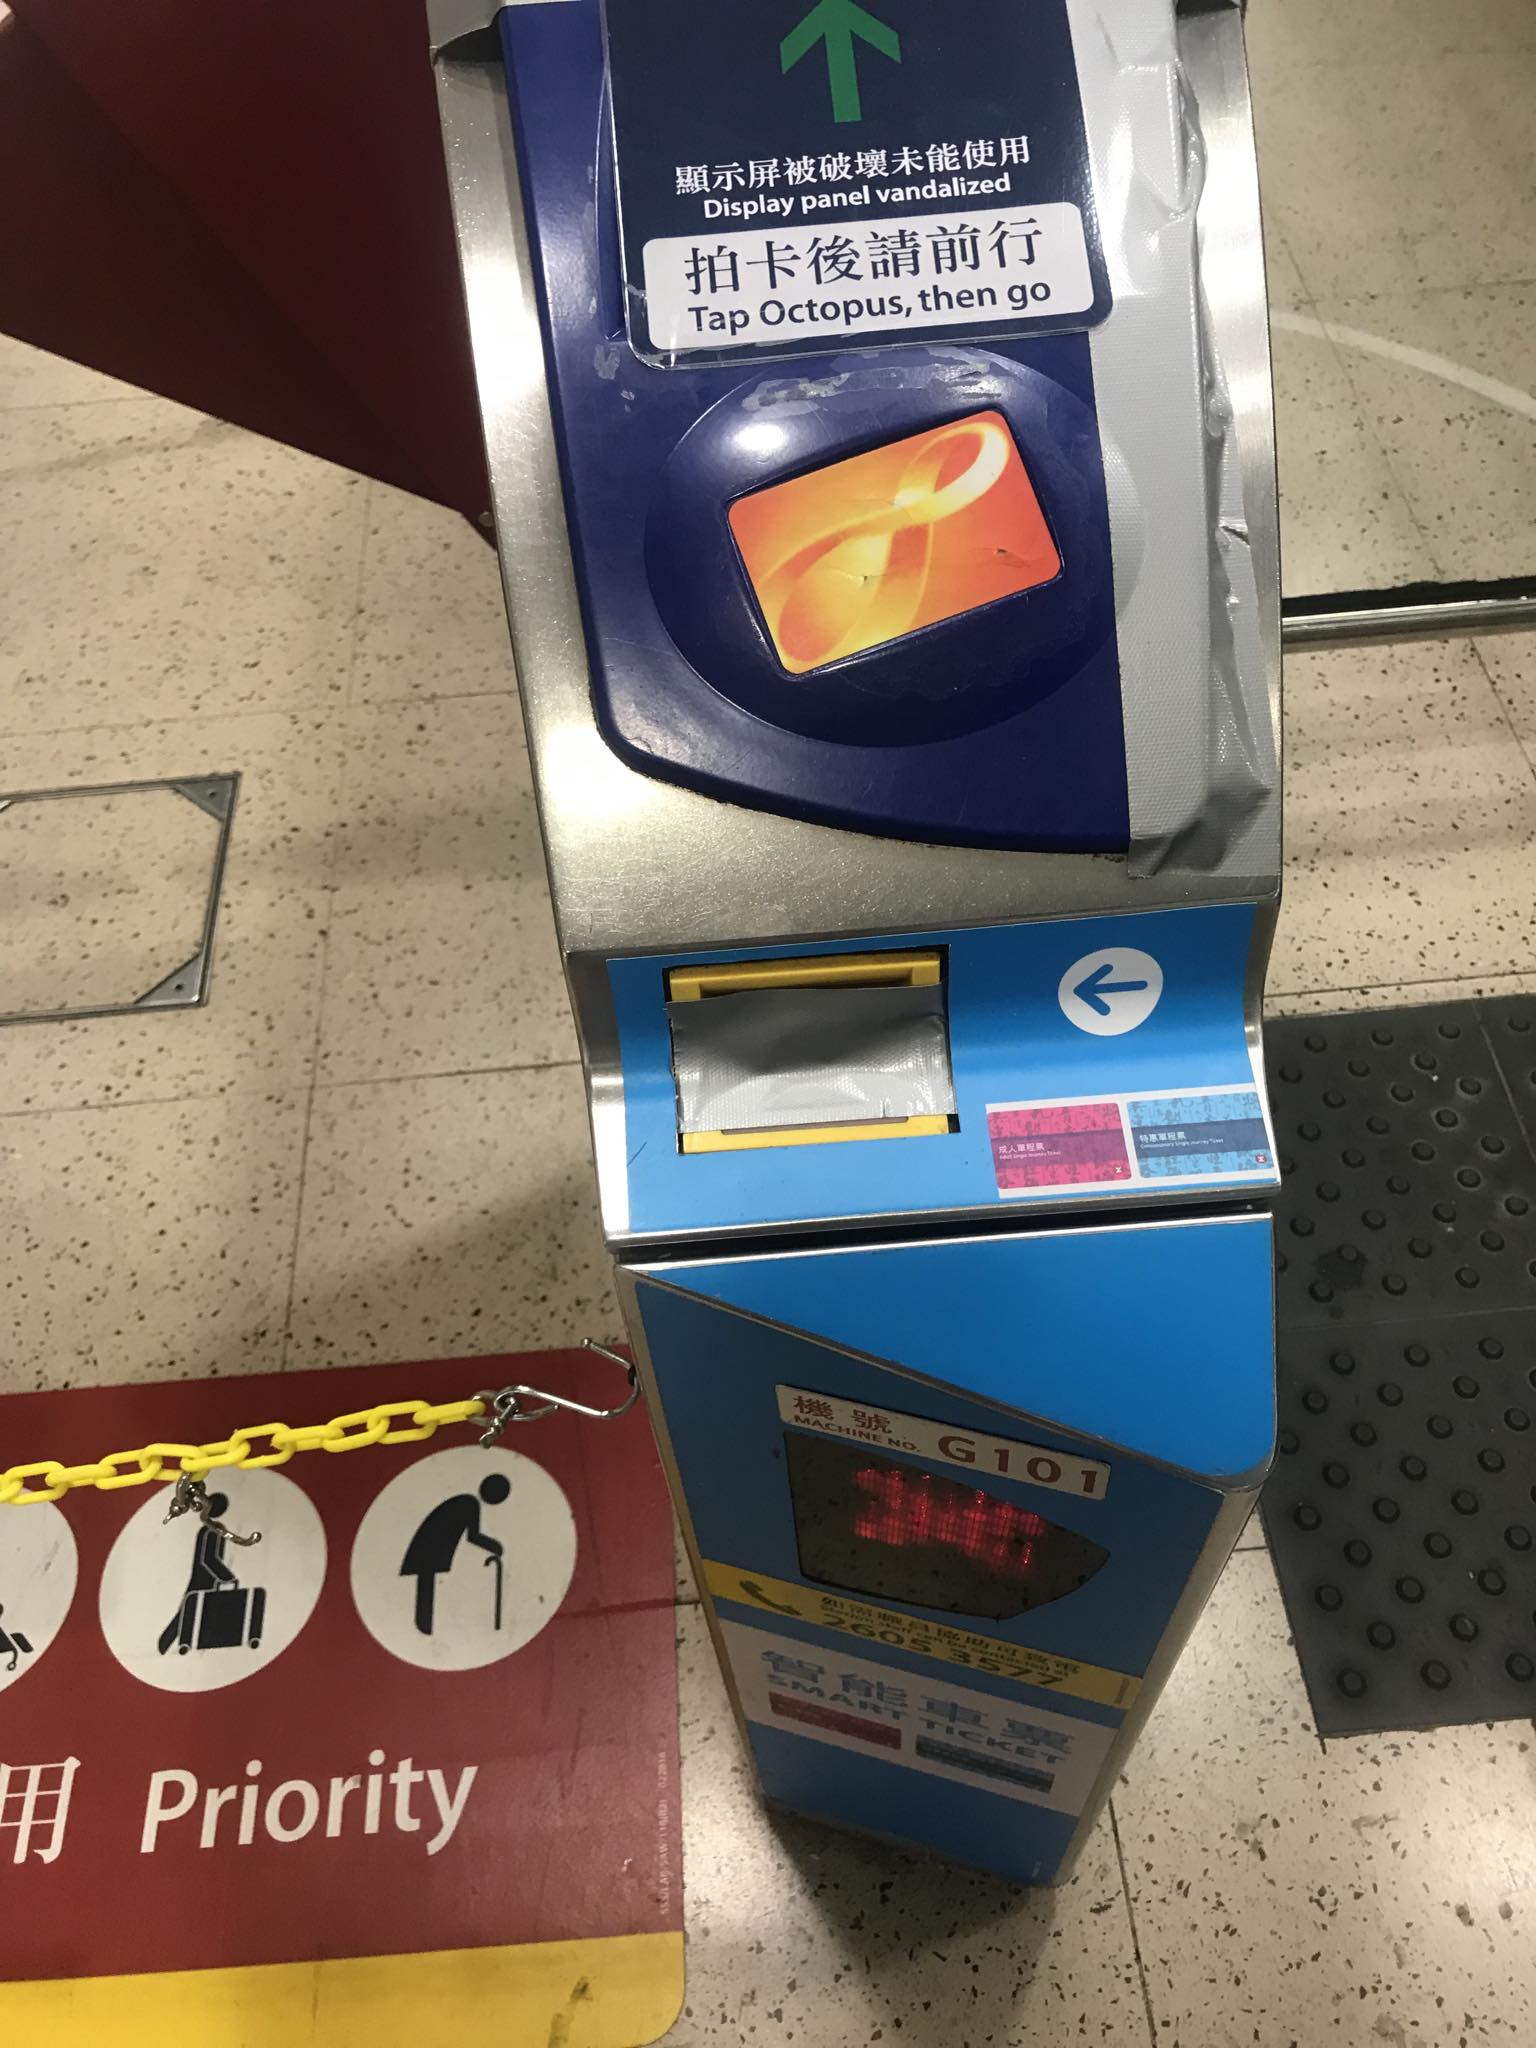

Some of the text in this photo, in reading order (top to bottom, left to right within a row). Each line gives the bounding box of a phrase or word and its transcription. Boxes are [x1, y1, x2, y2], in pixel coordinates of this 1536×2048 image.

[675, 135, 1031, 195] 顯示屏被破壞未能使用
[703, 172, 1012, 221] Display panel vandalized
[683, 217, 1043, 296] 拍卡後請前行
[688, 279, 1052, 336] Tap Octopus, then go
[793, 1395, 892, 1434] 機號
[794, 1415, 1099, 1493] MACHINE NO. G101
[823, 1613, 932, 1652] 2605
[768, 1673, 1072, 1765] SMART TICKET
[0, 1755, 81, 1865] 用
[140, 1749, 479, 1856] Priority
